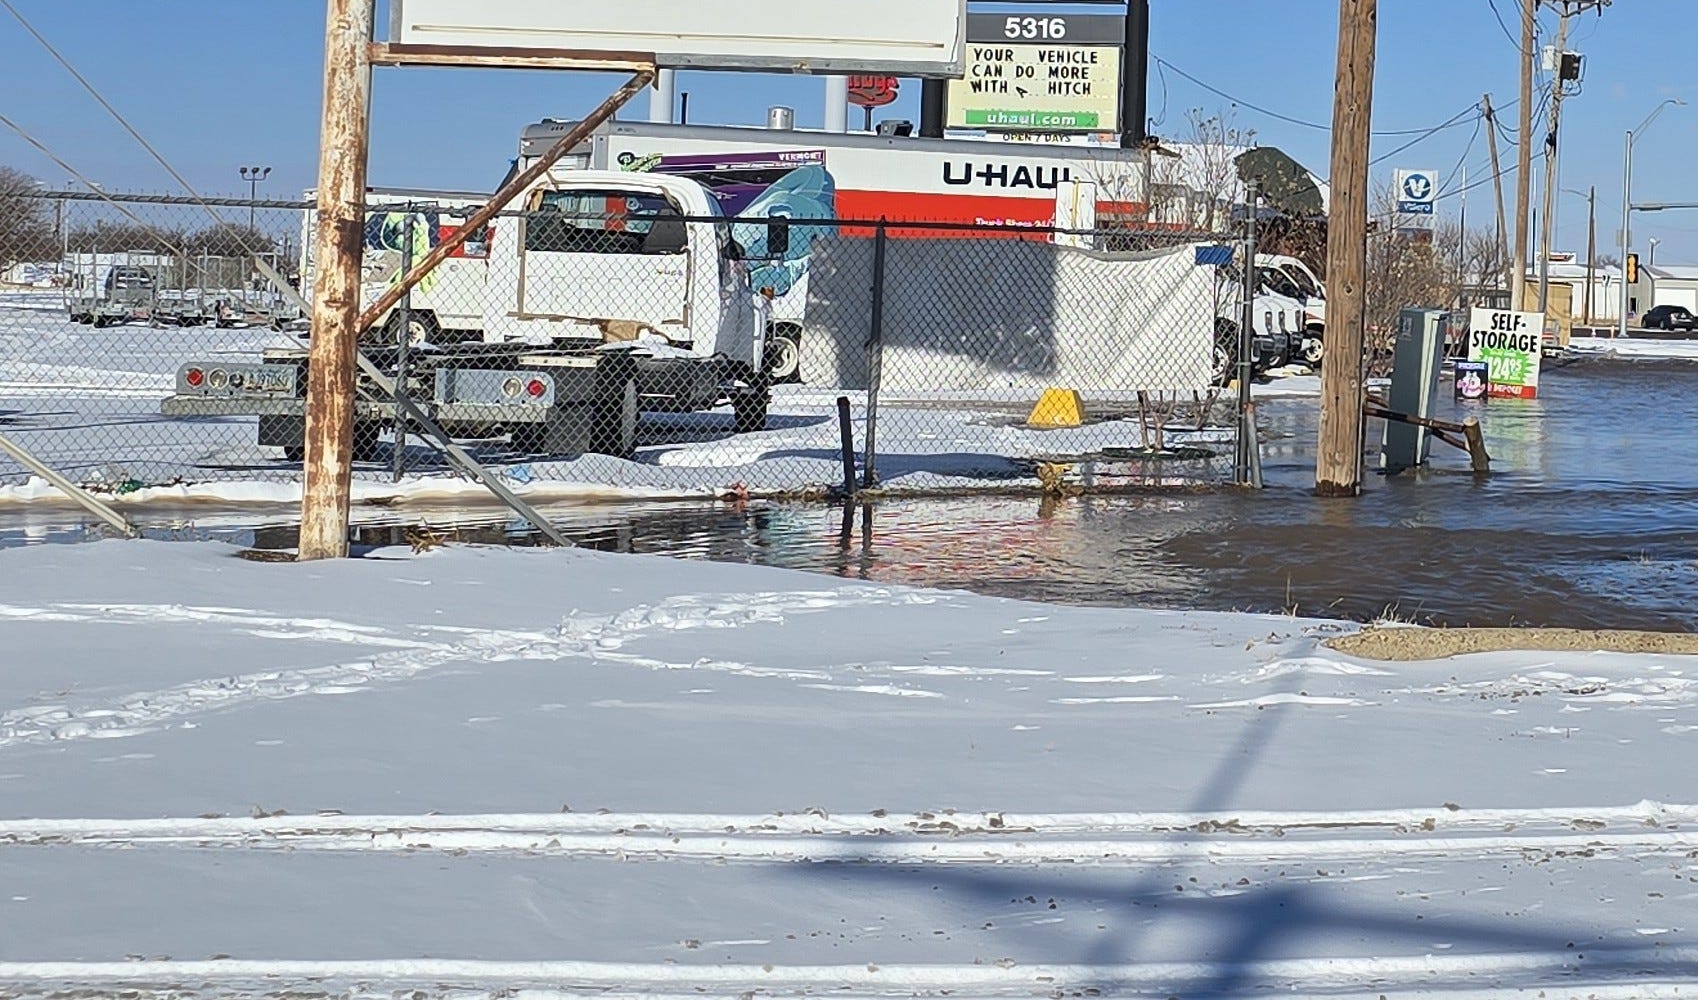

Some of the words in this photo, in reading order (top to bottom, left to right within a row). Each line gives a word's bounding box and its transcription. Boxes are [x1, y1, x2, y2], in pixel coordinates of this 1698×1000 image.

[1004, 17, 1066, 39] 5316
[974, 48, 1014, 62] YOUR
[1038, 50, 1098, 64] VEHICLE
[972, 65, 1003, 77] CAN
[1015, 66, 1035, 79] DO
[1048, 67, 1089, 80] MORE
[970, 80, 1008, 94] WITH
[1015, 85, 1029, 99] A
[1048, 81, 1092, 96] HITCH
[987, 112, 1077, 126] uhaul.com
[1002, 133, 1032, 142] OPEN
[1044, 134, 1071, 143] DAYS
[1491, 313, 1526, 331] SELF-
[1472, 330, 1538, 353] STORAGE
